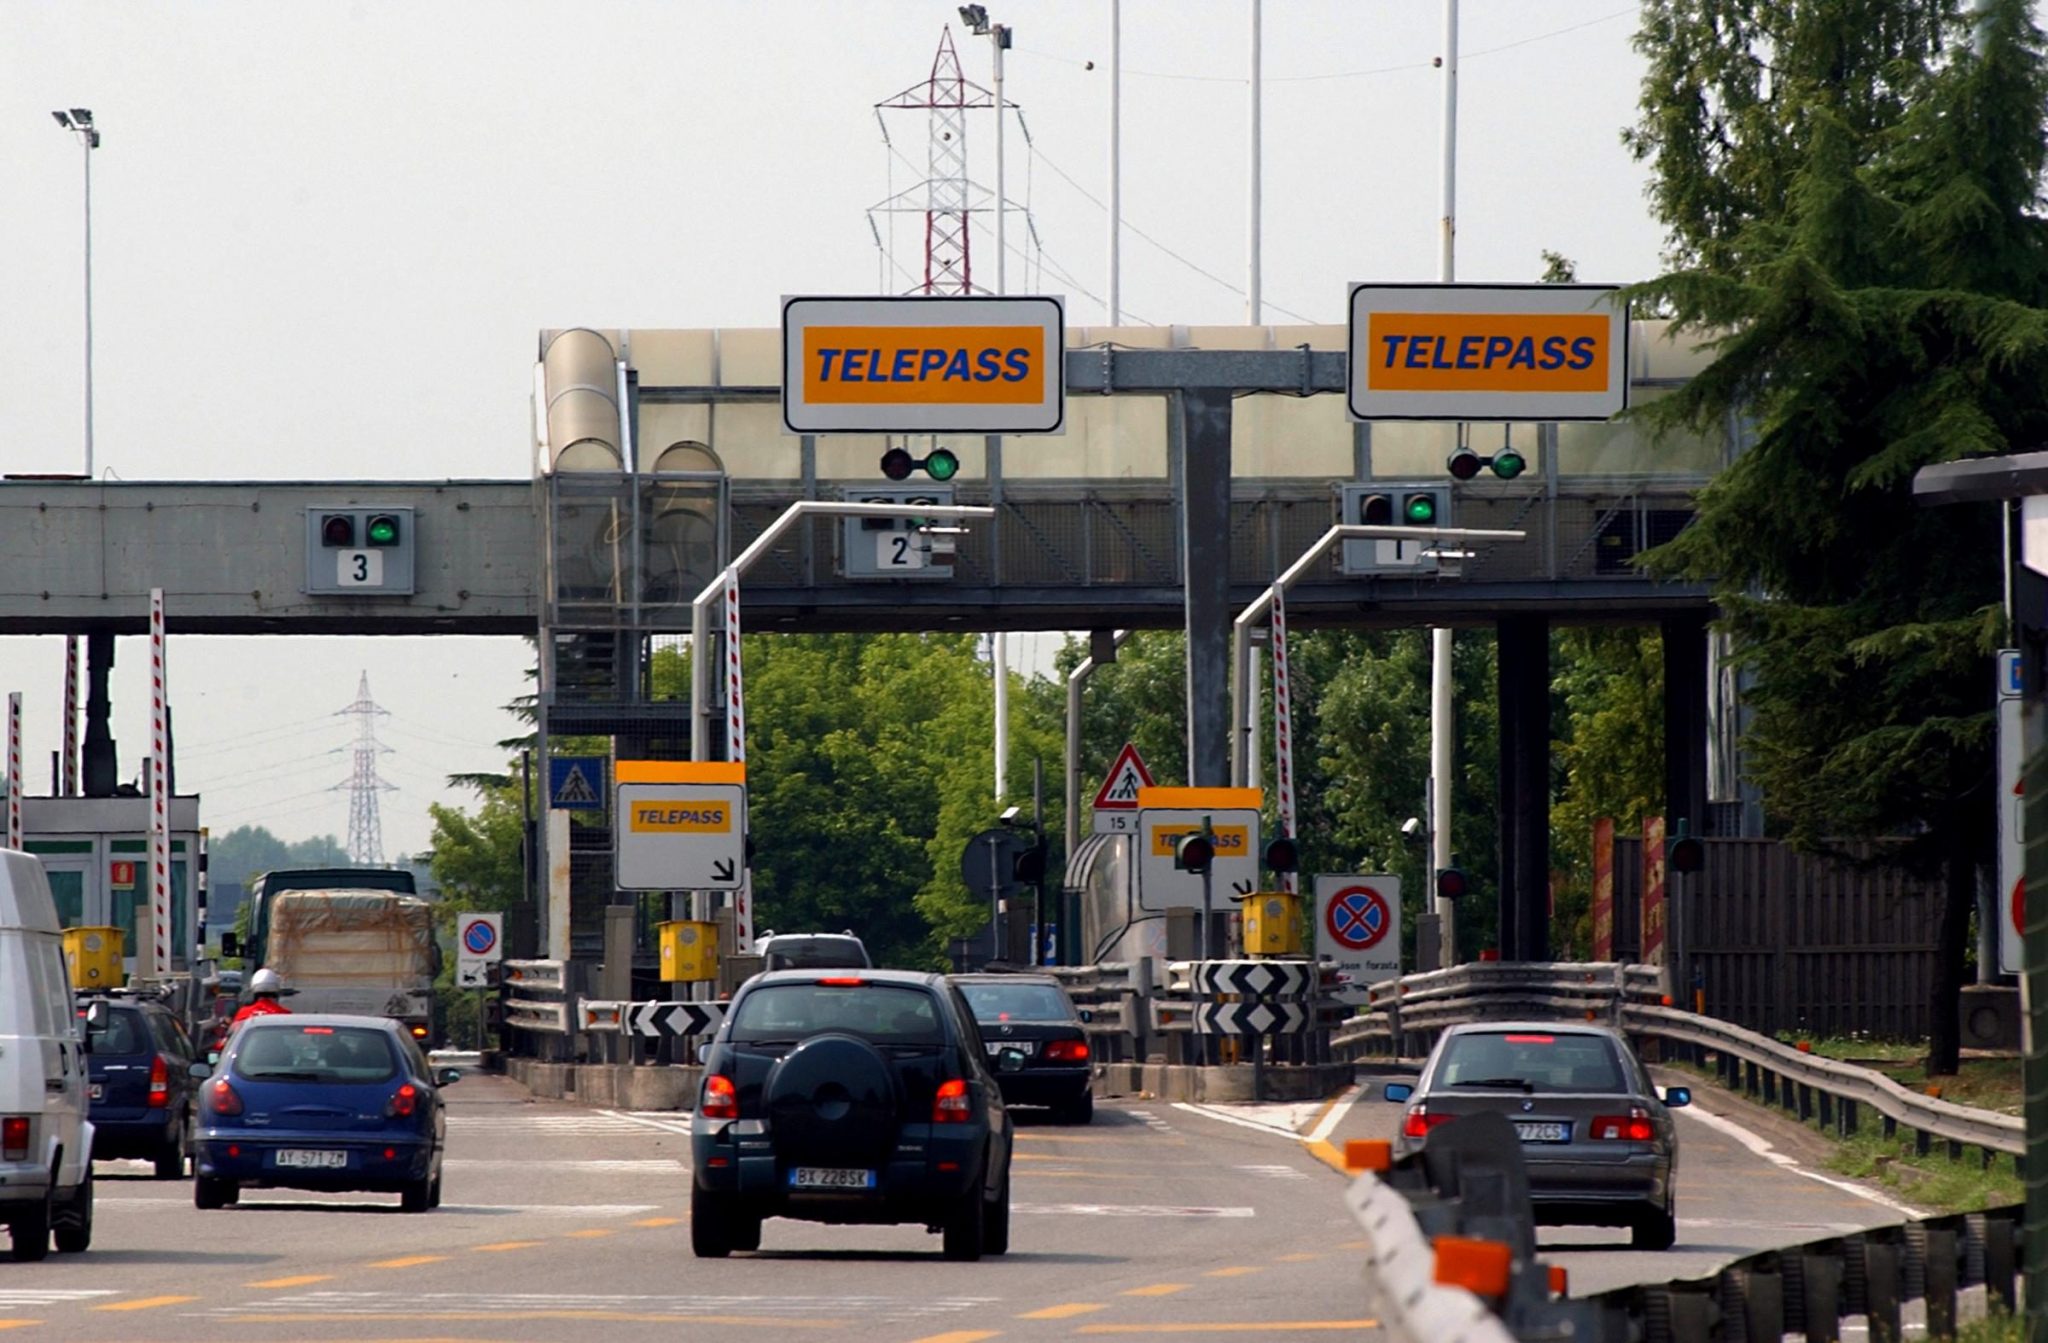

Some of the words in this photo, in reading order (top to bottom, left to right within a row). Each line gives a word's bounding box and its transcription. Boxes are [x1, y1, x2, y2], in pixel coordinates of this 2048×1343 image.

[817, 347, 1031, 382] TELEPASS
[1382, 335, 1596, 370] TELEPASS
[892, 537, 908, 565] 2
[353, 554, 367, 582] 3
[638, 810, 723, 825] TELEPASS
[1111, 817, 1126, 830] 15
[1159, 833, 1242, 847] TEASS
